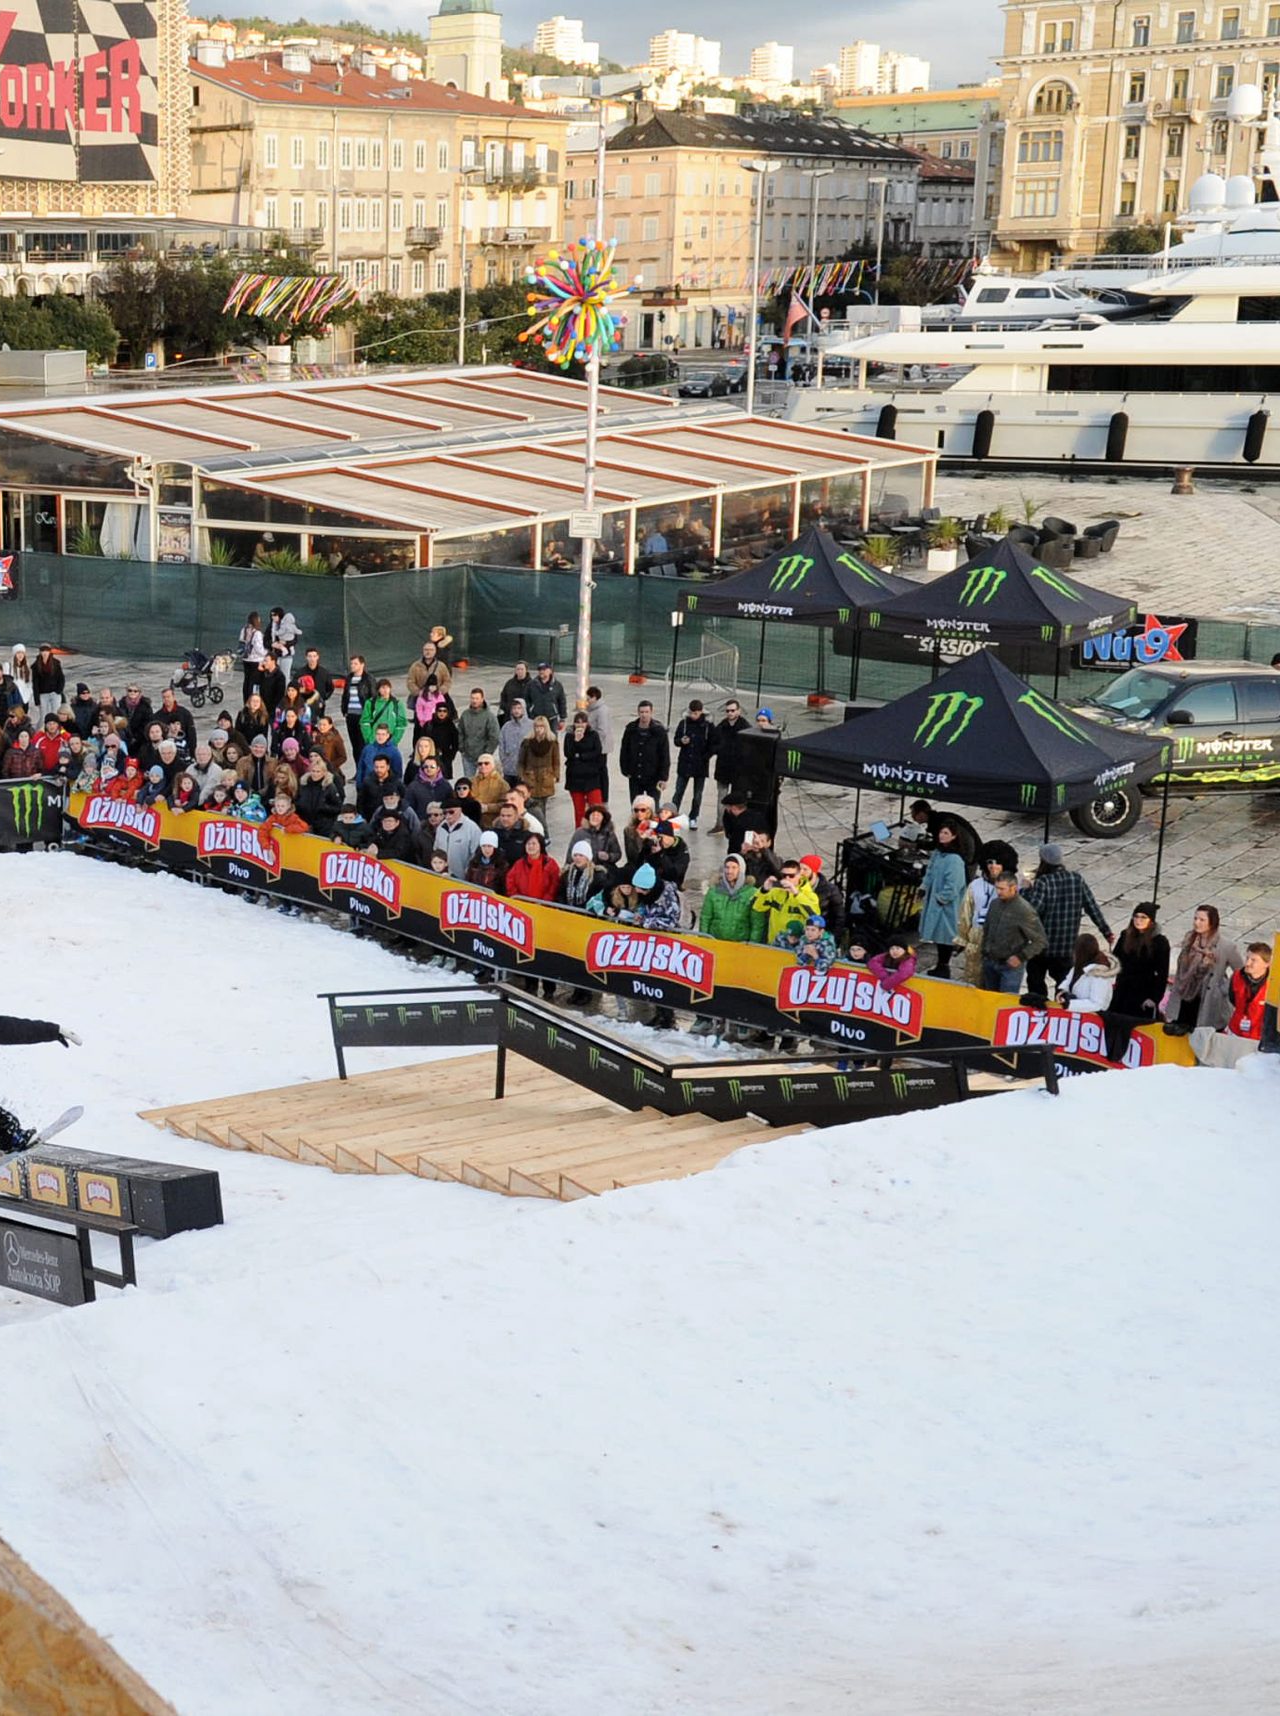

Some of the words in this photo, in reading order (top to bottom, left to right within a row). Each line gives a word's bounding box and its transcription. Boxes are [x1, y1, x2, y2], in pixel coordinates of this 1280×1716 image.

[738, 603, 794, 616] MONSTER
[926, 618, 991, 633] MONSTER
[1197, 739, 1274, 755] MONSTER
[862, 763, 949, 788] MONSTER
[874, 781, 935, 795] ENERGY
[228, 863, 250, 879] Pivo
[325, 853, 394, 903] Ožujsko
[349, 897, 370, 915] Pivo
[446, 893, 526, 946] Ožujsko
[473, 938, 495, 958] Pivo
[595, 934, 703, 983] Ožujsko
[632, 980, 663, 999] Pivo
[788, 969, 910, 1025] Ožujsko
[830, 1020, 866, 1041] Pivo
[1006, 1009, 1142, 1068] Ožujso
